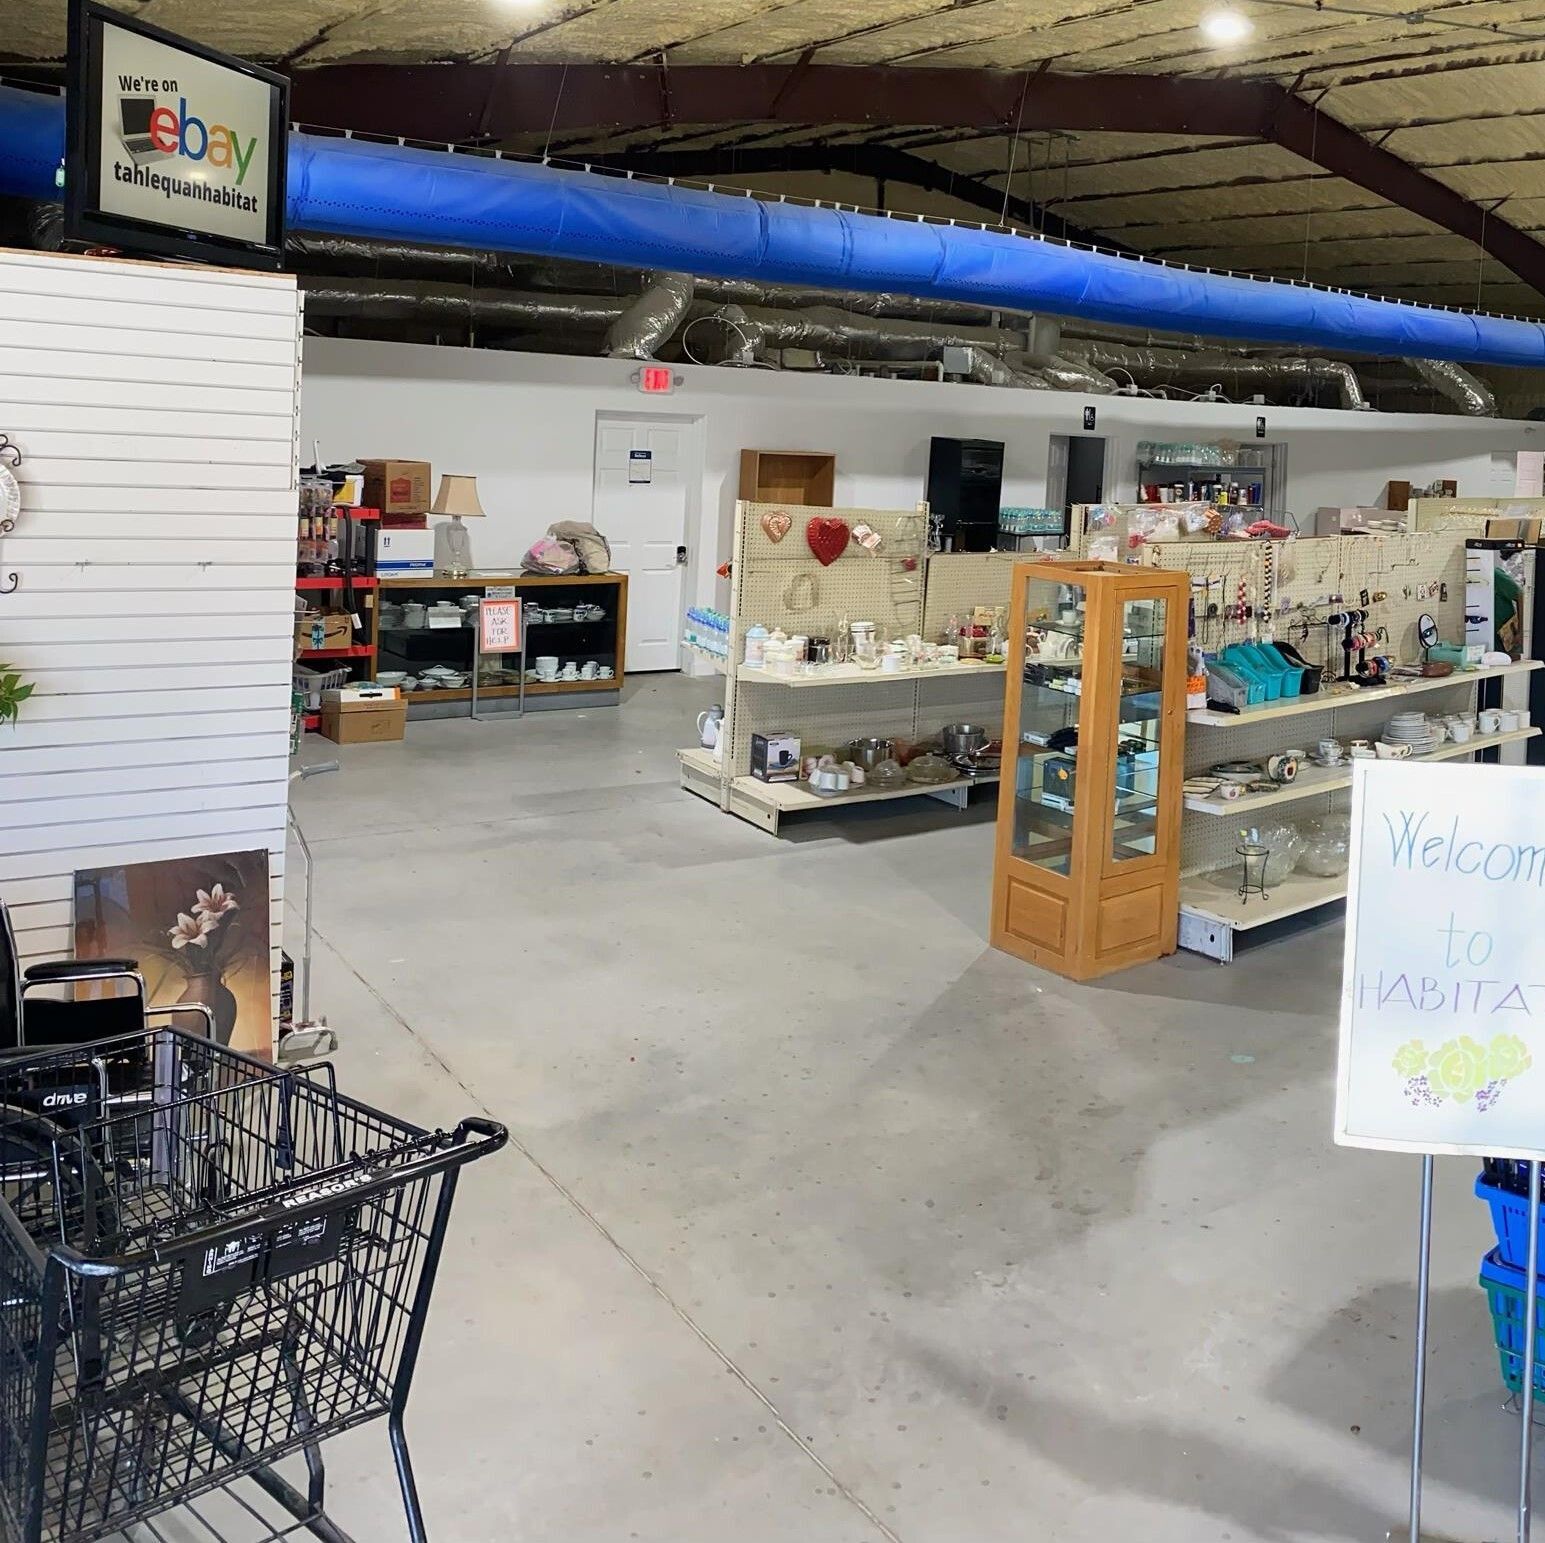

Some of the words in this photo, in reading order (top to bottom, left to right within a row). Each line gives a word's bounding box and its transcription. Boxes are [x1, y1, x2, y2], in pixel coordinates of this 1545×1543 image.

[119, 75, 159, 92] We're
[162, 80, 178, 92] on
[149, 97, 258, 186] ebay
[485, 606, 511, 615] PLEASE
[1437, 912, 1493, 968] to
[42, 1092, 88, 1107] drive
[282, 1174, 373, 1208] REASOR'S
